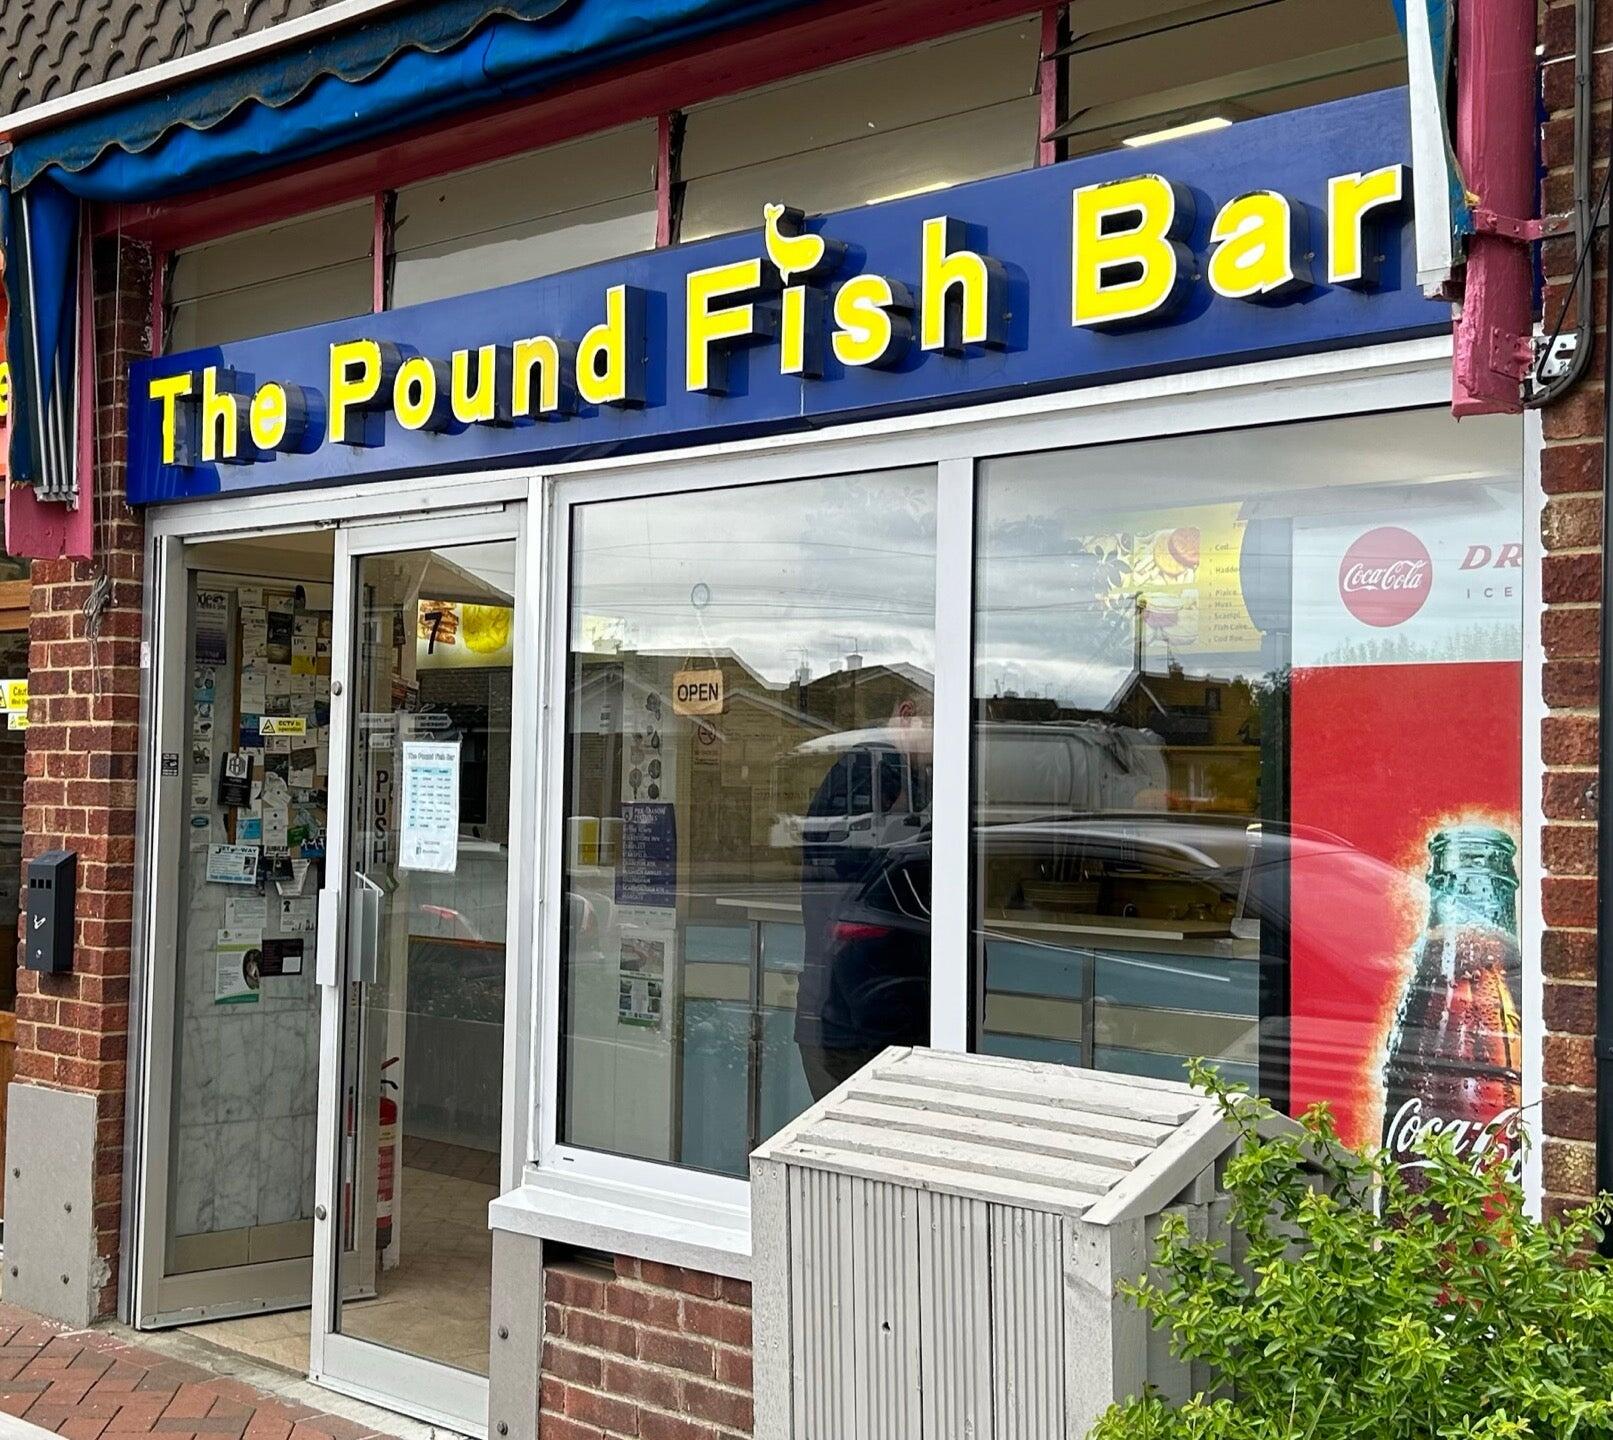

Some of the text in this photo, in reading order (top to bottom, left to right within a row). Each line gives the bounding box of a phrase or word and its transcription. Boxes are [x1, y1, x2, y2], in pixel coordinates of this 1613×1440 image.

[149, 164, 1402, 466] The Pound Fish Bar
[1458, 542, 1523, 571] DR
[1343, 559, 1428, 592] Coca-Cola
[1467, 586, 1513, 599] ICE
[424, 611, 443, 655] 7
[677, 682, 719, 702] OPEN
[373, 769, 389, 864] PUSH
